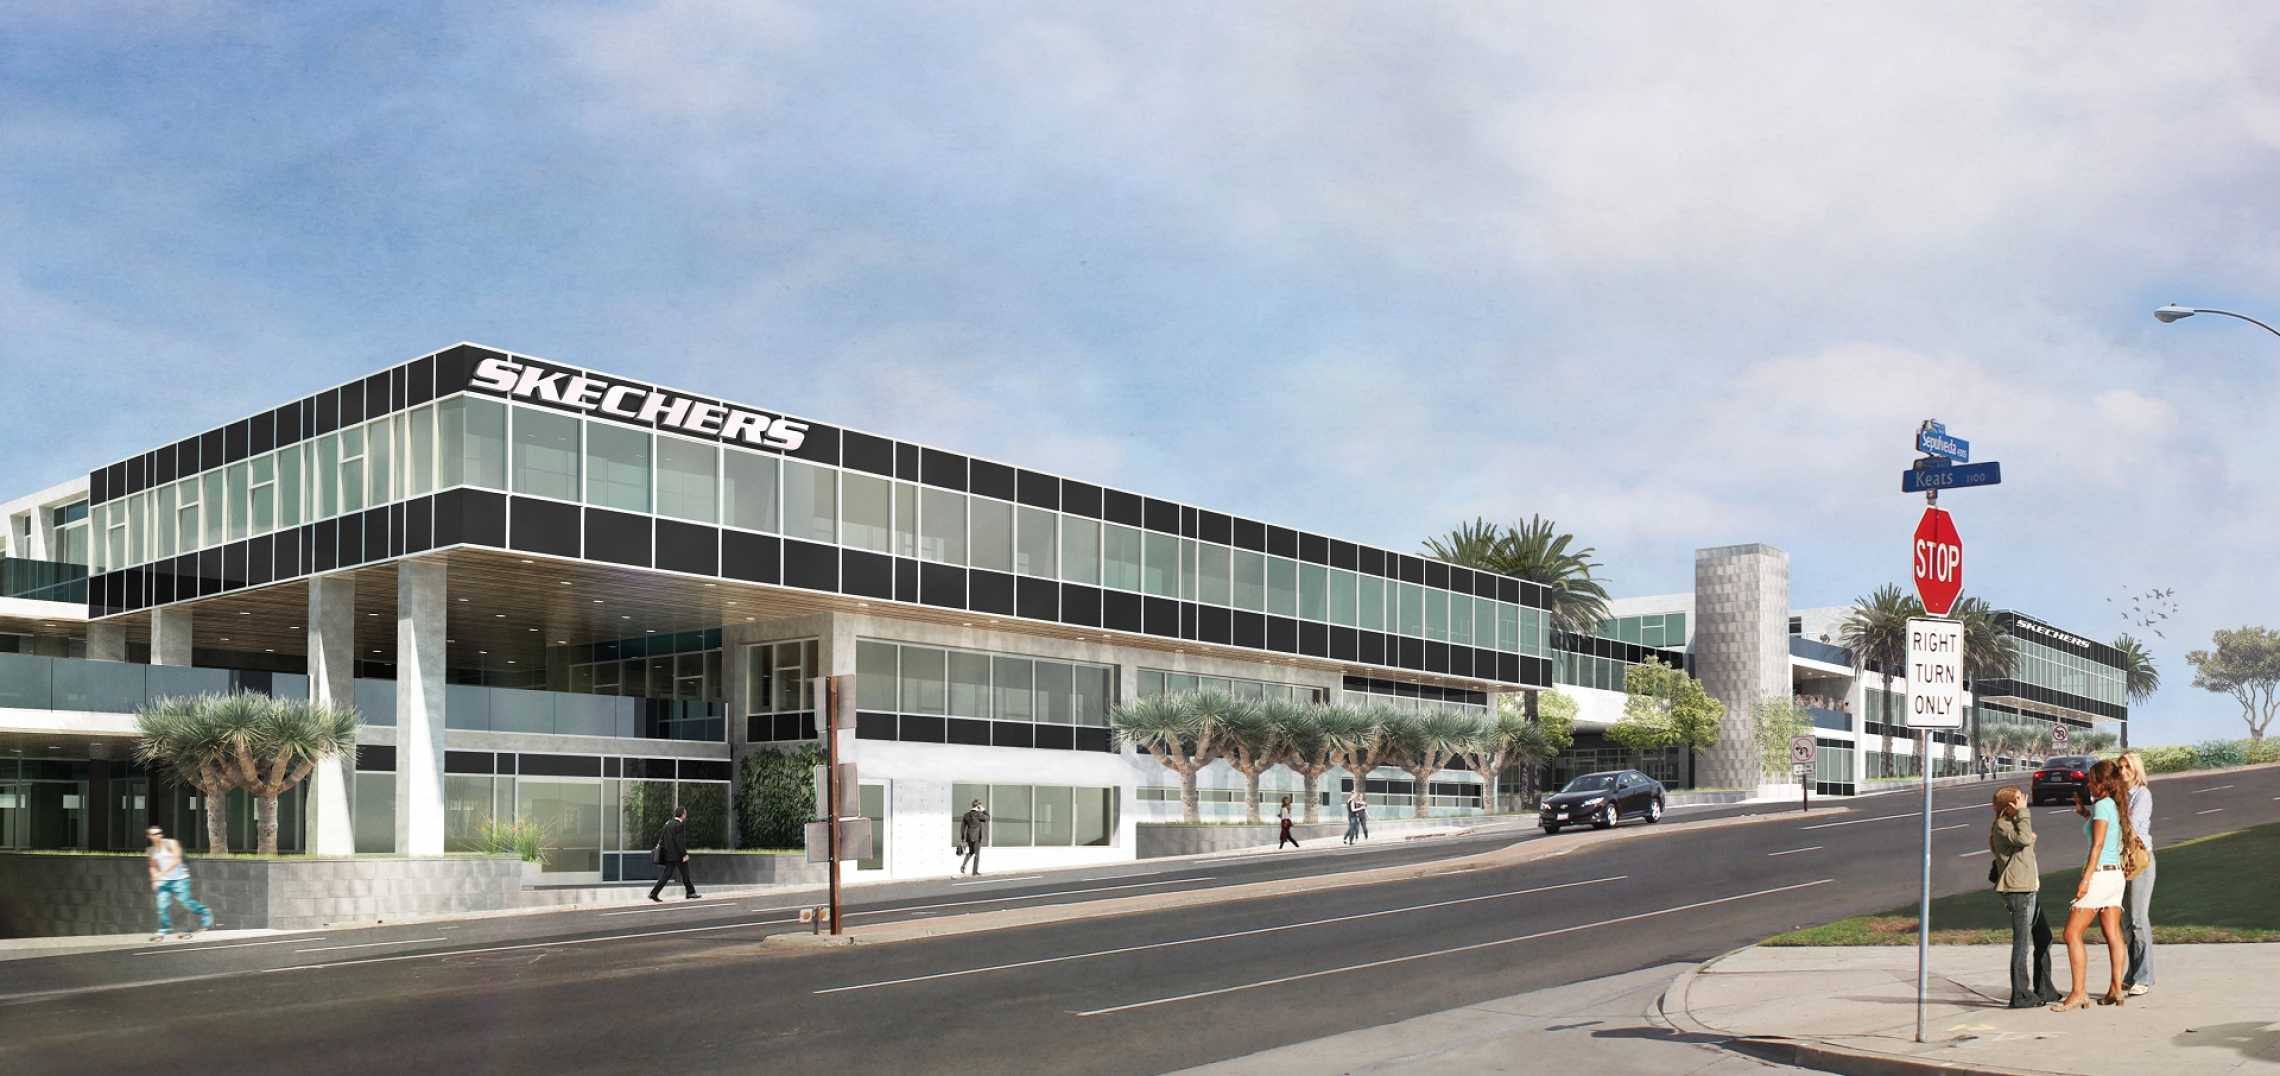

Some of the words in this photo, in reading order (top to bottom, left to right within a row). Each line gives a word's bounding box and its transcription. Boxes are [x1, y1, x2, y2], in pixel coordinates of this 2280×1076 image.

[471, 357, 810, 451] SKECHERS
[1922, 431, 1957, 455] Sepulveda
[1915, 471, 1953, 488] Keats
[1916, 538, 1960, 583] STOP
[1913, 632, 1957, 653] RIGHT
[2016, 619, 2092, 649] SKECHERS
[1915, 663, 1955, 684] TURN
[1915, 695, 1953, 715] ONLY
